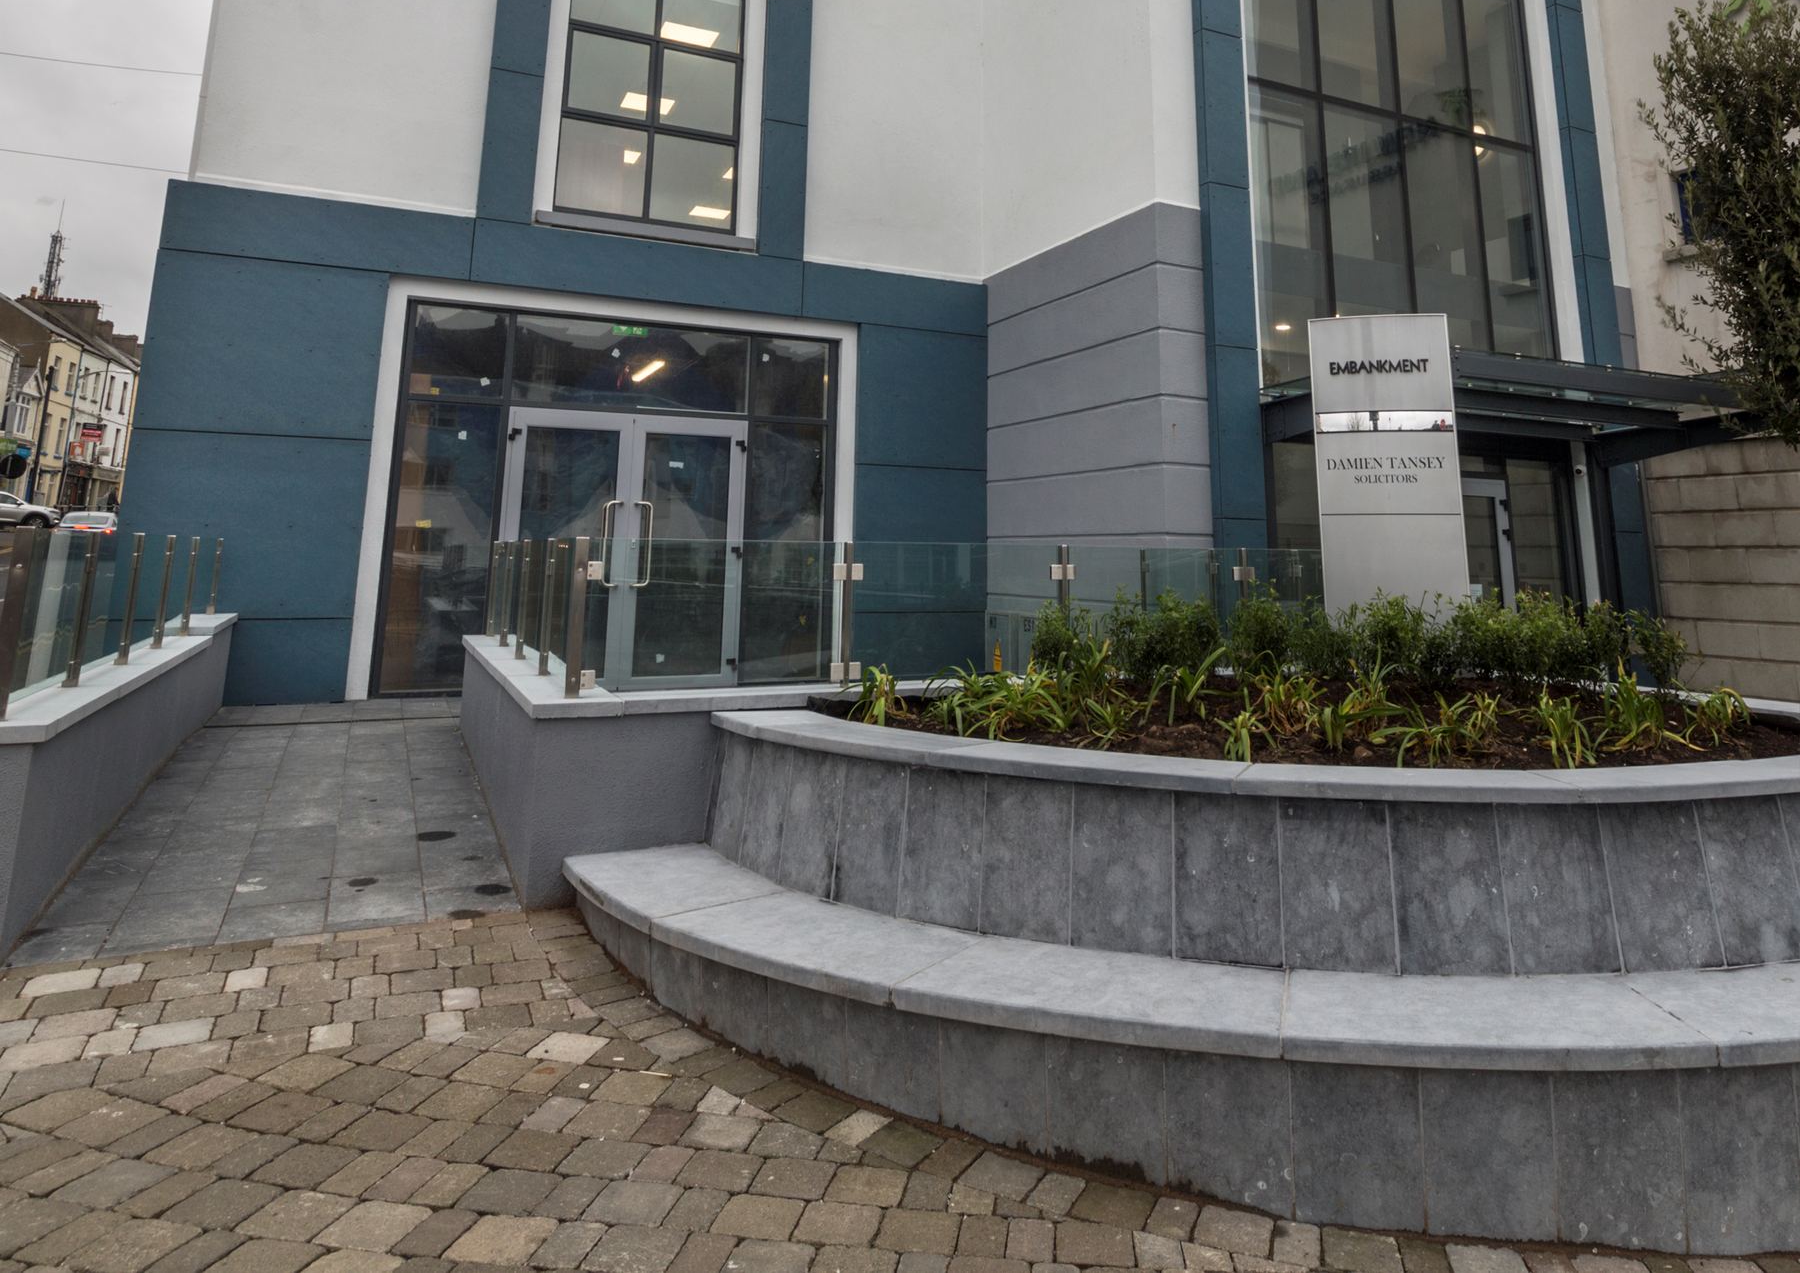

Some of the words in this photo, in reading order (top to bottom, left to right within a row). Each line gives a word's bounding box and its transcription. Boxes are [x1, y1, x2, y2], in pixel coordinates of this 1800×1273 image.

[1329, 359, 1428, 375] EMBANKMENT
[1327, 457, 1383, 471] DAMIEN
[1386, 456, 1445, 469] TANSEY
[1354, 474, 1418, 484] SOLICITORS
